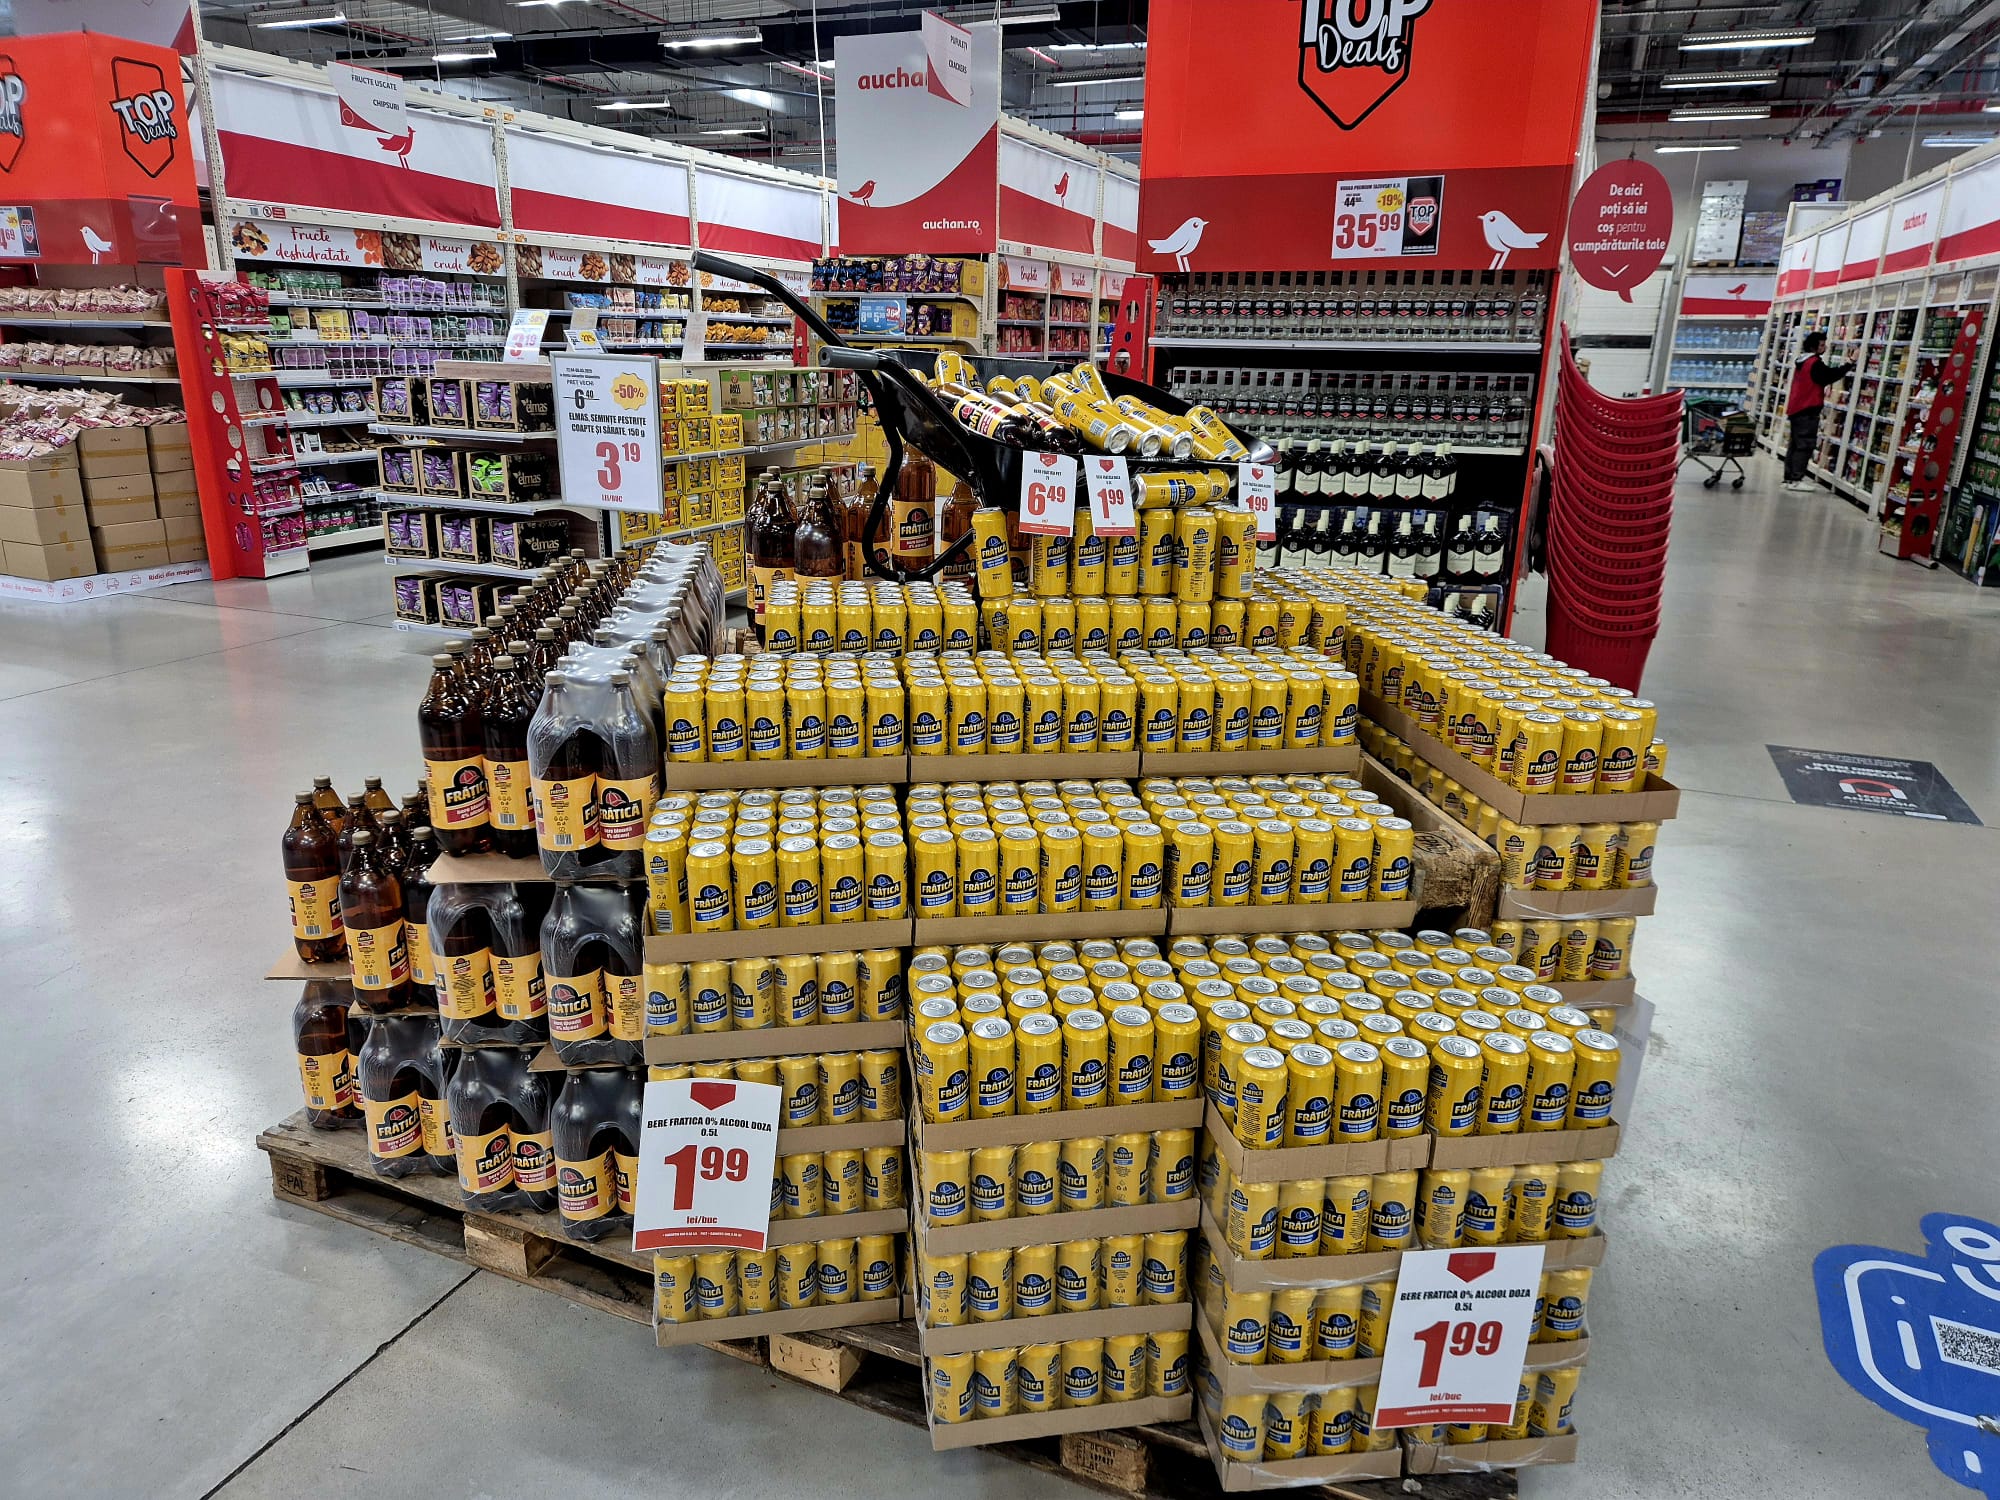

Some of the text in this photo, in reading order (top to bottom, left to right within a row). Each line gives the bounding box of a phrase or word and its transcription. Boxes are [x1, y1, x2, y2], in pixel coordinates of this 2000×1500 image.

[1319, 15, 1401, 69] Deals
[351, 74, 397, 90] FRUCTE USCATE
[858, 67, 928, 90] aucha
[112, 90, 173, 132] TOP
[373, 99, 400, 110] CHIPSURI
[136, 112, 176, 143] Deals
[1610, 183, 1643, 196] De aici
[1411, 205, 1434, 218] TOP
[1622, 202, 1634, 214] să
[1635, 202, 1648, 214] iei
[923, 219, 979, 230] auchan.ro
[1616, 222, 1646, 235] pentru
[290, 227, 331, 243] Fructe
[429, 239, 464, 253] Mixuri
[1646, 238, 1666, 249] tale
[275, 245, 351, 263] deshidratate
[548, 250, 576, 263] Mixuri
[433, 255, 463, 270] crude
[552, 266, 576, 279] crude
[615, 384, 644, 399] -50%
[526, 401, 548, 413] elmas
[572, 424, 594, 433] COAPTE
[628, 427, 640, 437] 150
[519, 472, 541, 485] elmas
[531, 537, 559, 551] elmas
[647, 1117, 772, 1132] BERE FRATICA 0% ALCOOL DOZA
[701, 1128, 718, 1137] 0.5L
[686, 1215, 718, 1224] lei/buc
[1401, 1289, 1531, 1301] BERE FRATICA 0% ALCOOL DOZA
[1454, 1302, 1473, 1311] 0.5L
